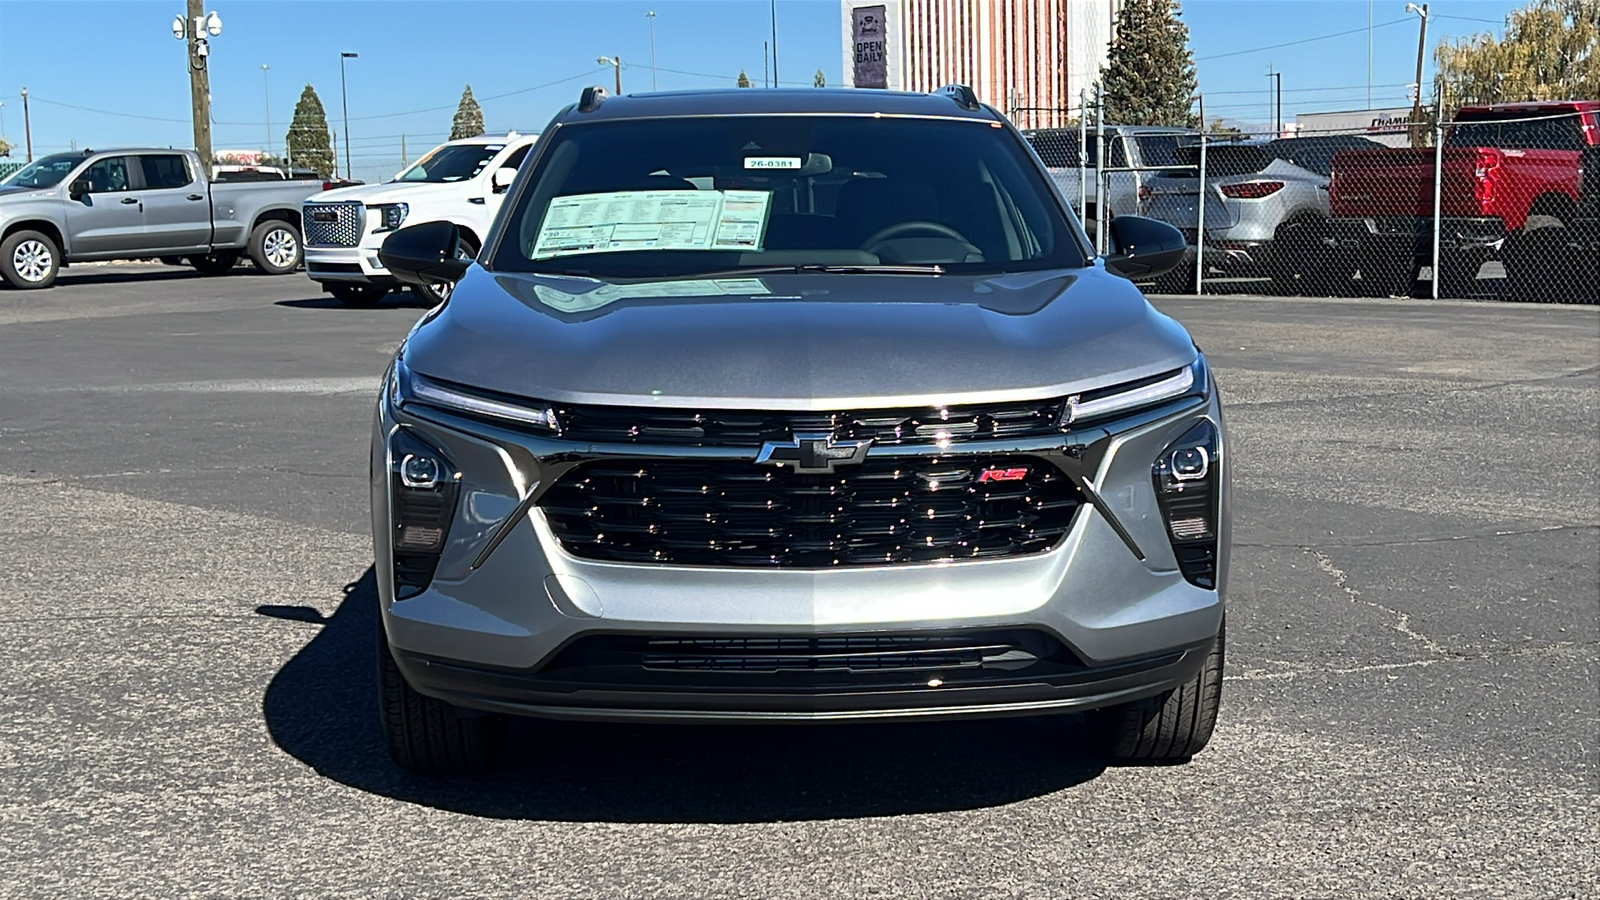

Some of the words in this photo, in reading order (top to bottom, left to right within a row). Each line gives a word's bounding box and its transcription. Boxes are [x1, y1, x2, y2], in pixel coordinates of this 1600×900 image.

[857, 41, 882, 53] OPEN
[857, 52, 883, 63] DAILY
[979, 468, 1028, 482] RS
